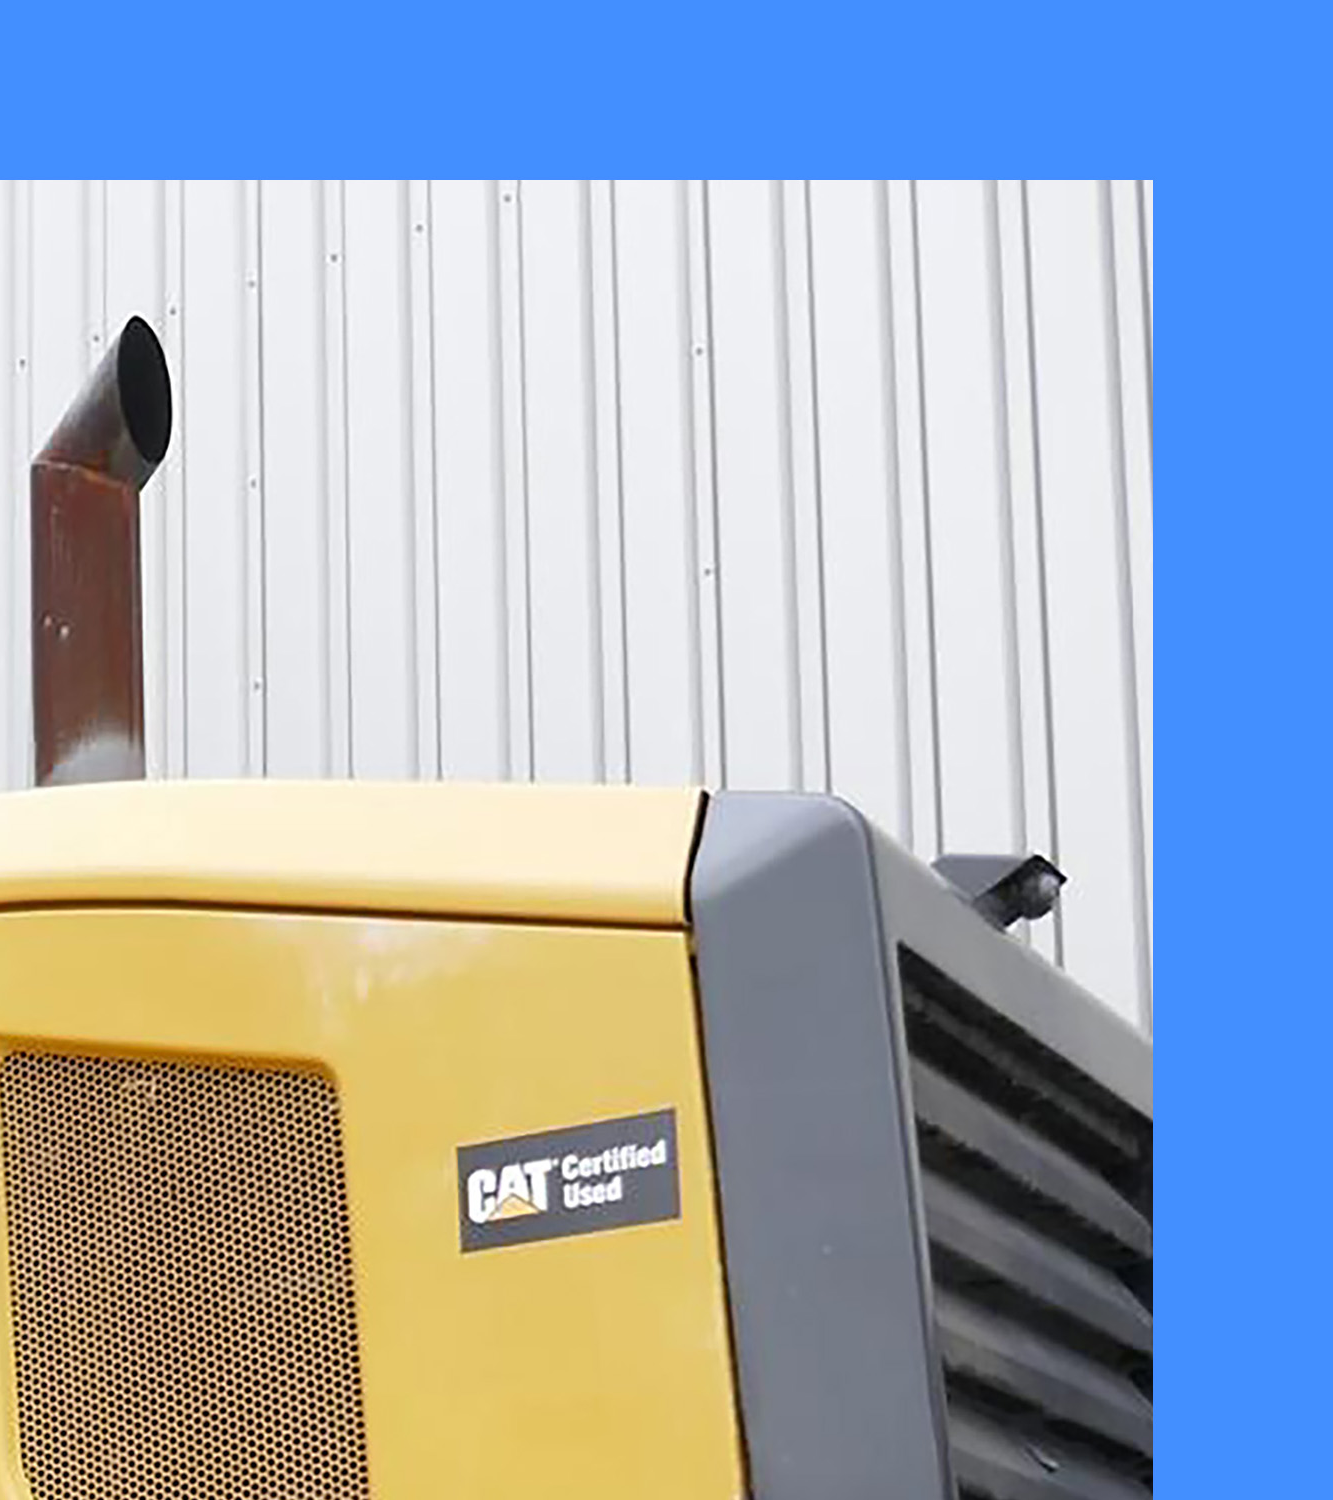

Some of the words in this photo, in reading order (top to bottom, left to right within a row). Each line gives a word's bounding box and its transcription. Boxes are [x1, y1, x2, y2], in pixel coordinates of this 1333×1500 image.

[466, 1158, 553, 1224] CAT
[561, 1138, 667, 1181] Certified
[562, 1174, 624, 1209] Used
